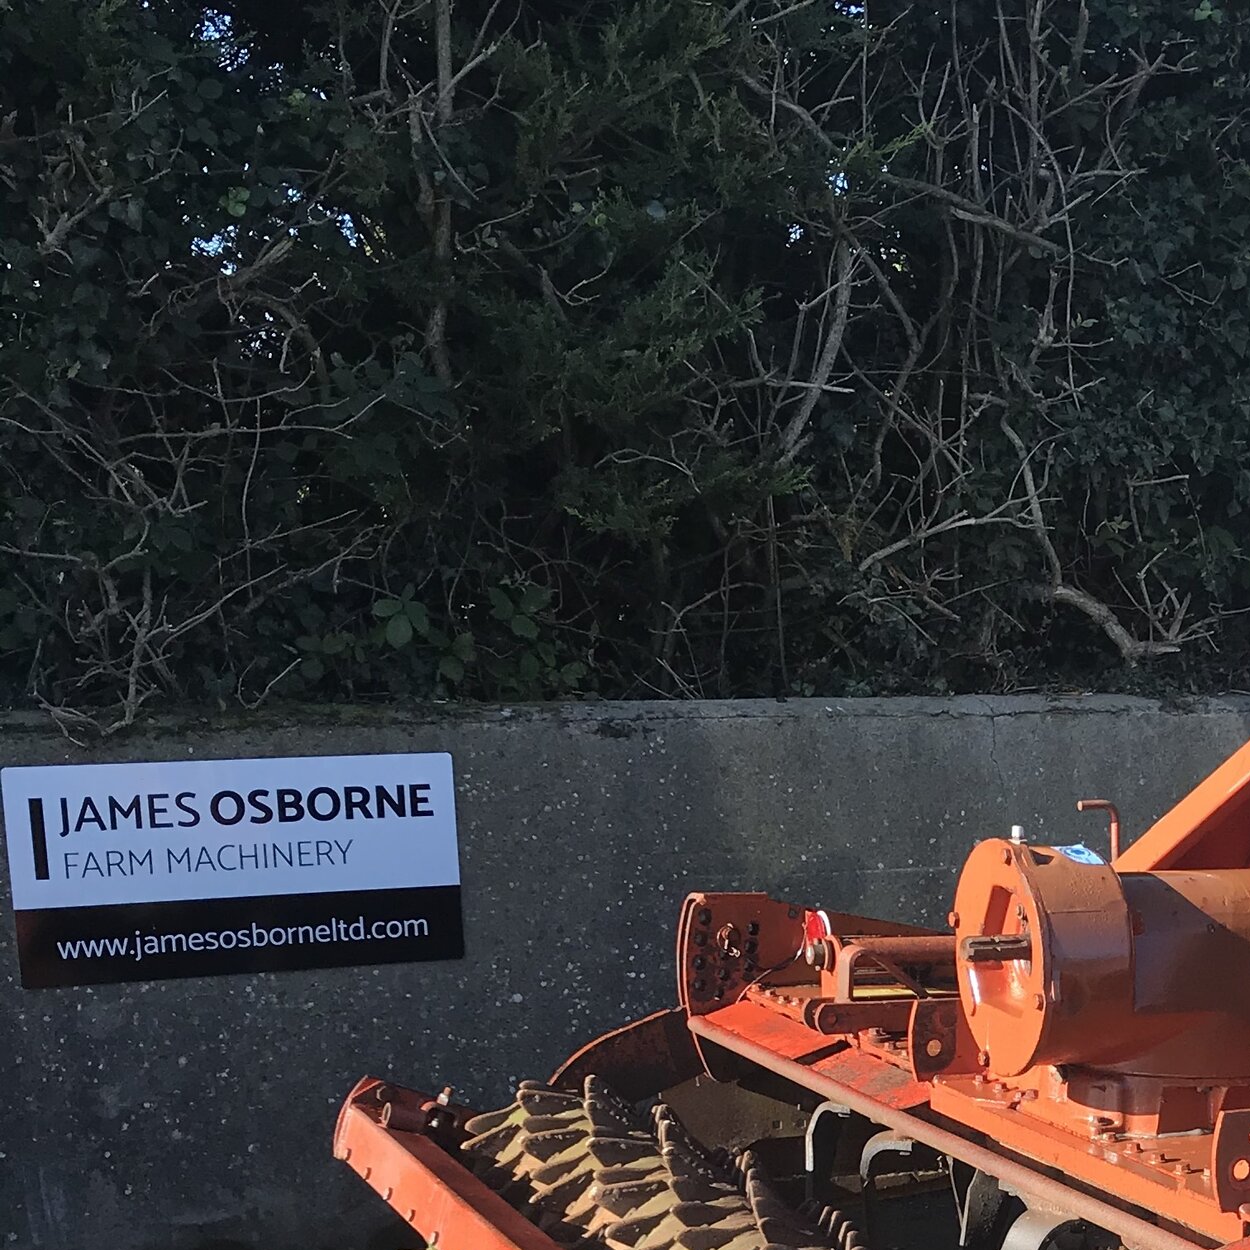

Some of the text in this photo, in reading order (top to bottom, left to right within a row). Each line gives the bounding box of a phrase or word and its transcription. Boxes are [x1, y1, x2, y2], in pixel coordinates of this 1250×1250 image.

[58, 783, 435, 837] JAMES OSBORNE
[63, 839, 354, 880] FARM MACHINERY
[57, 916, 429, 961] www.jamesosborneltd.com
